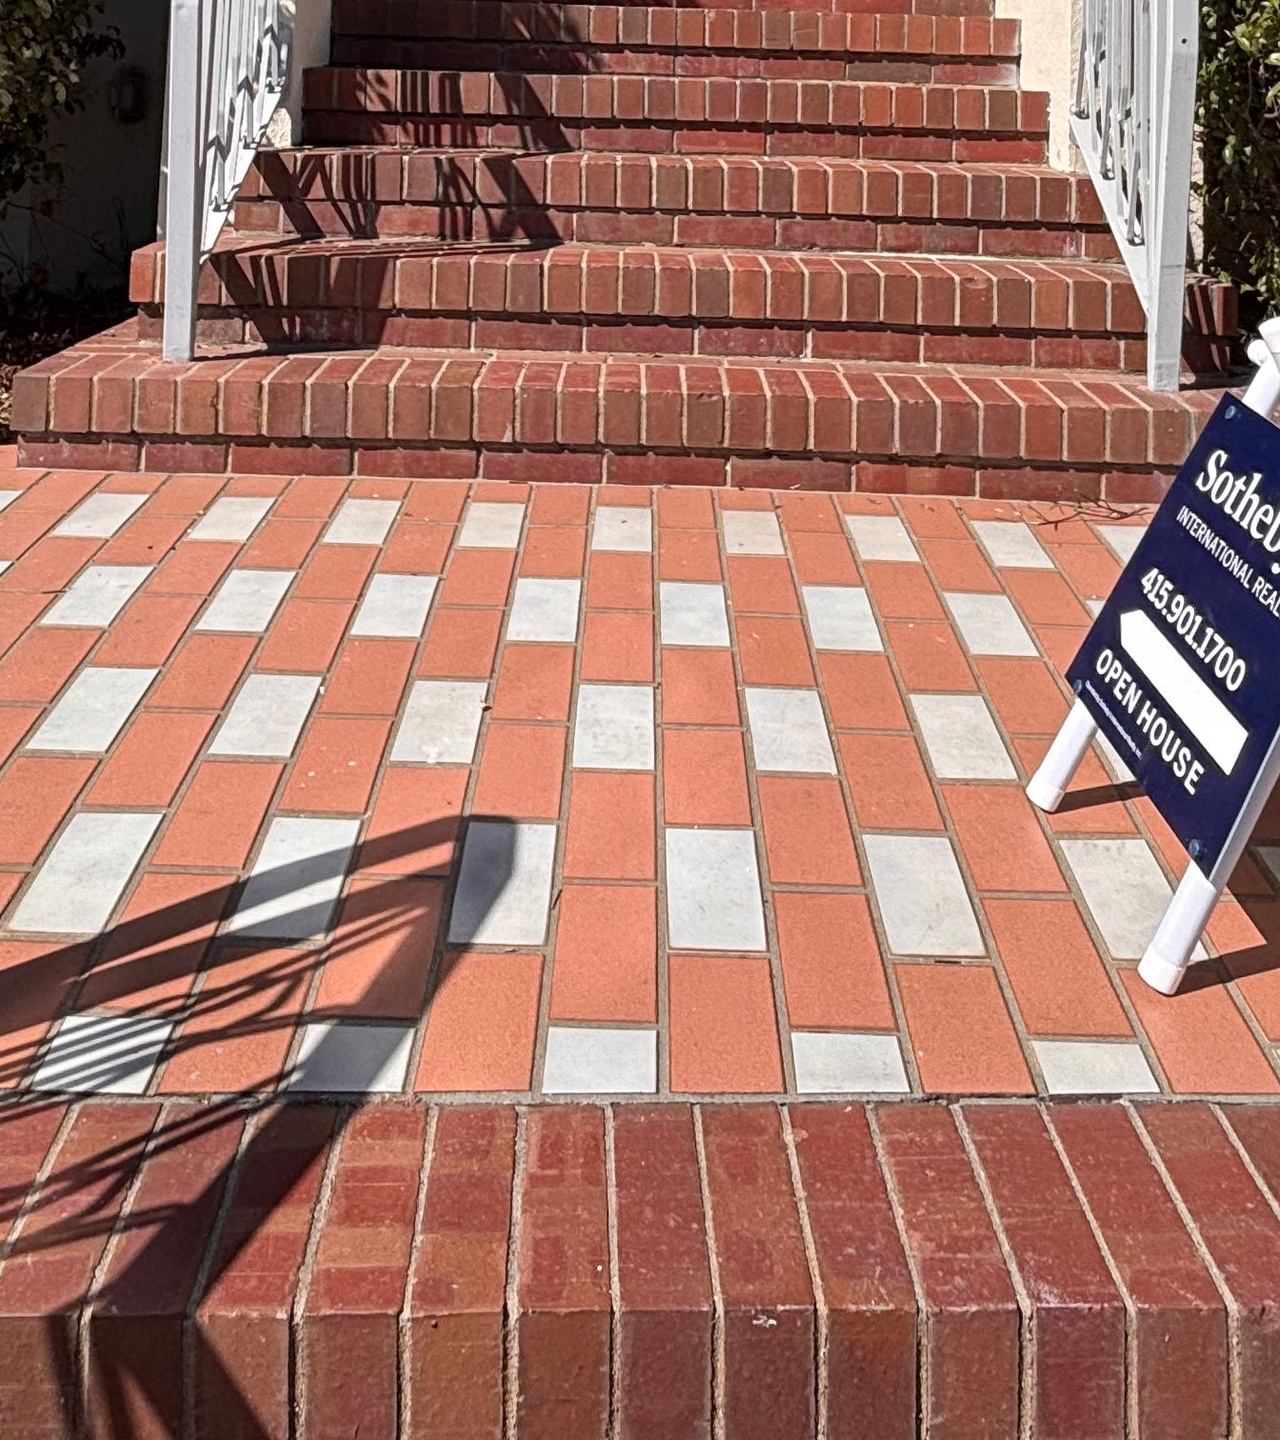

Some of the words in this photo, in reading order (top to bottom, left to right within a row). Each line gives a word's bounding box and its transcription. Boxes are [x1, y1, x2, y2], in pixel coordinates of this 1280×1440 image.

[1176, 505, 1254, 588] INTERNATIONAL
[1140, 568, 1246, 692] 415.901.1700
[1095, 648, 1142, 714] OPEN
[1136, 700, 1205, 796] HOUSE
